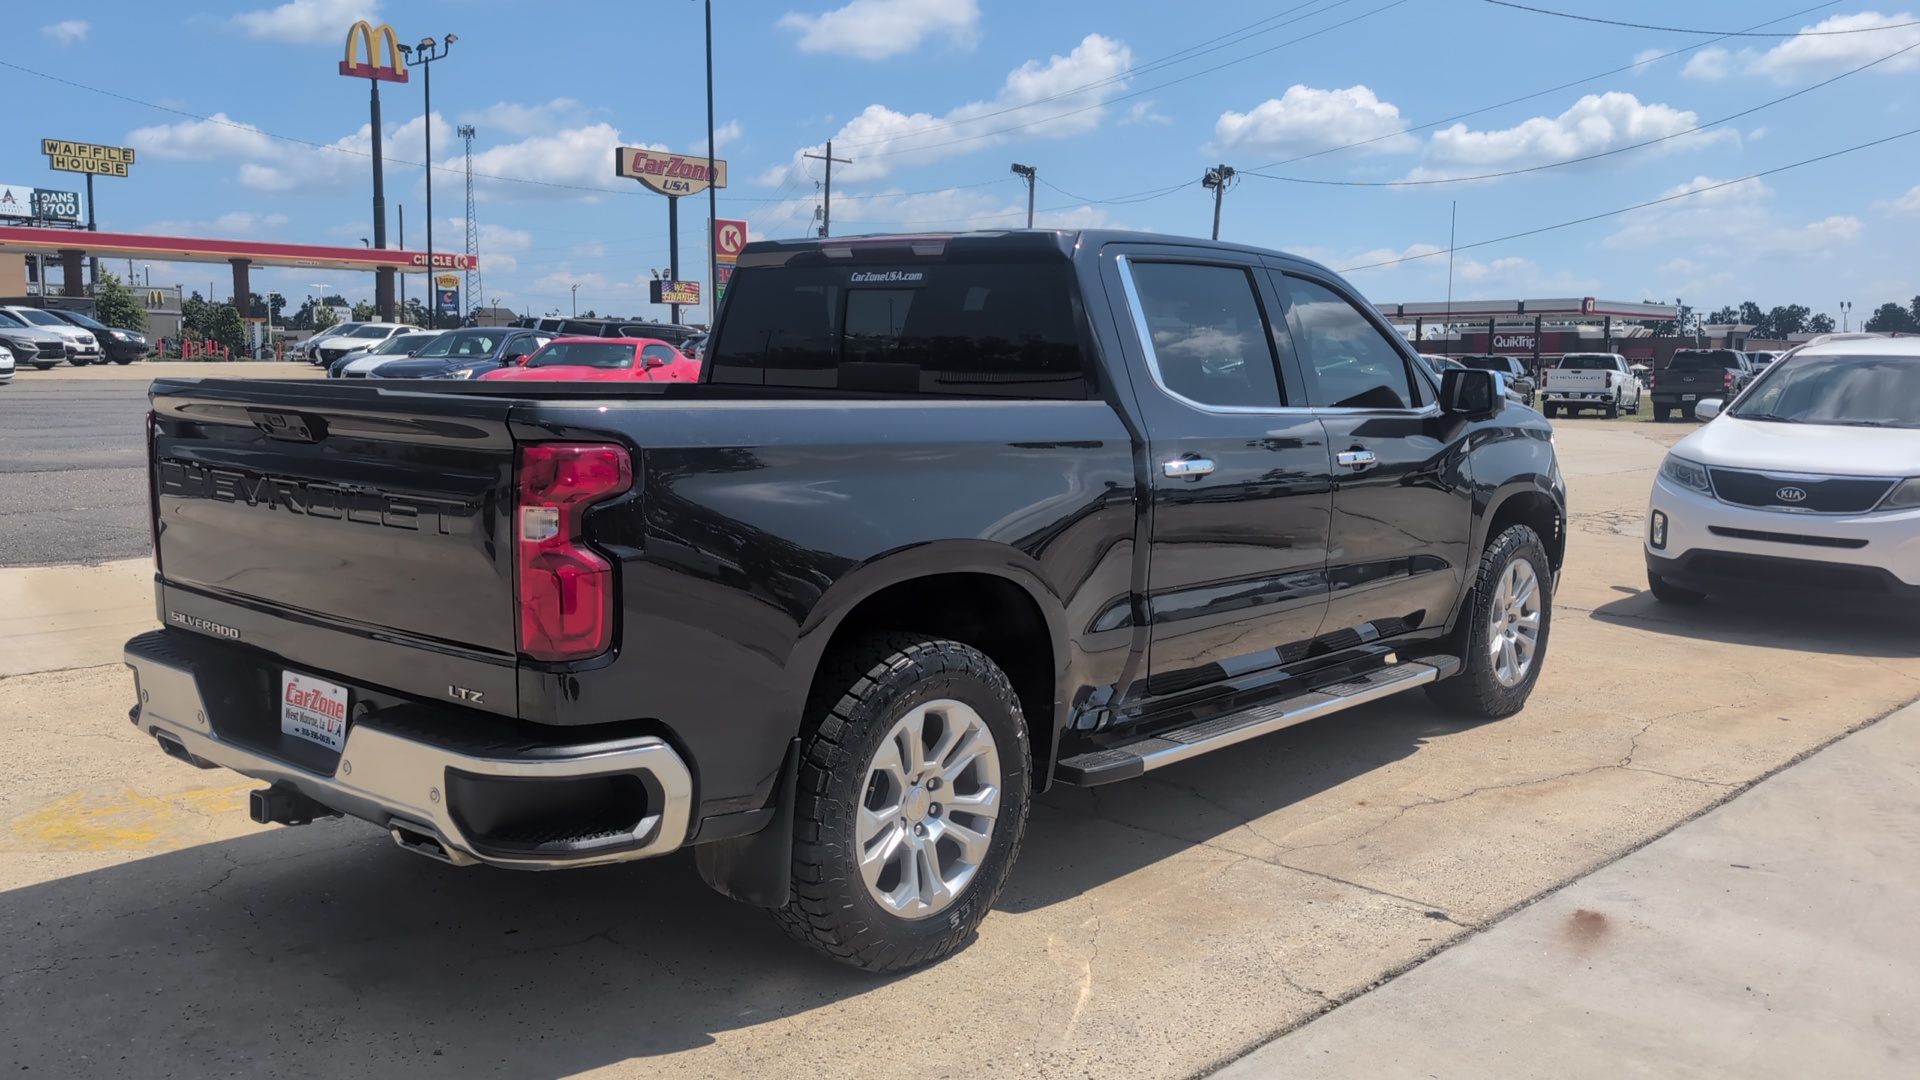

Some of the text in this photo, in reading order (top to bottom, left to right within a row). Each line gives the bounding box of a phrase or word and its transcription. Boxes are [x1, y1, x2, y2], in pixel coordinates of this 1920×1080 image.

[46, 141, 132, 161] WAFFLE
[56, 157, 125, 174] HOUSE
[663, 179, 690, 192] USA
[42, 203, 76, 215] $700
[851, 271, 923, 282] CarZoneUSA.com
[664, 293, 697, 302] FINANCE
[1493, 335, 1536, 349] QuikTrip
[160, 460, 467, 535] CHEVROLET
[1780, 489, 1802, 499] KIA
[171, 611, 240, 638] SILVERADO
[285, 682, 344, 720] CarZone
[449, 685, 484, 704] LTZ
[285, 707, 299, 721] West
[327, 719, 341, 737] UA
